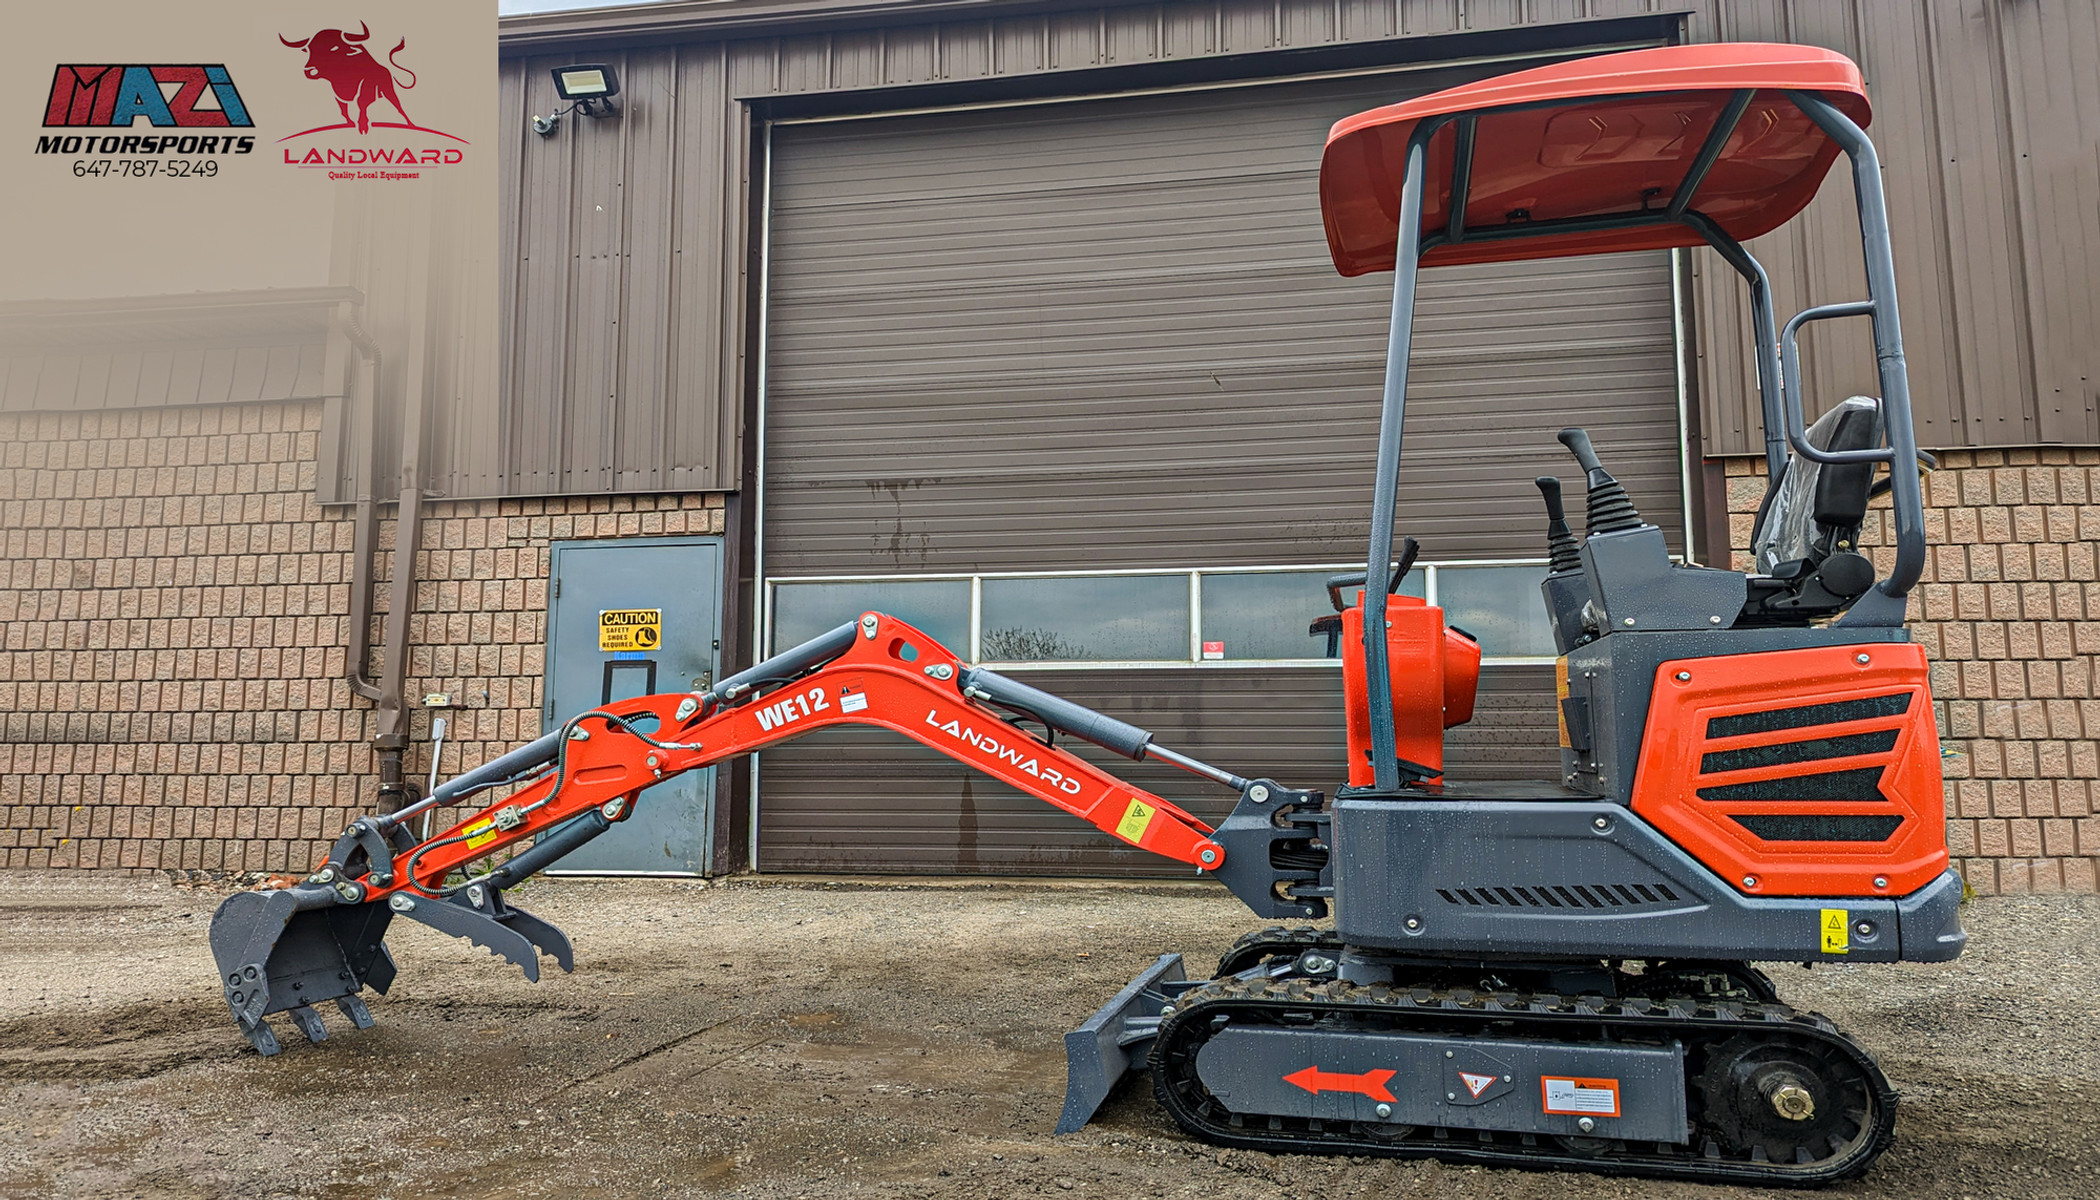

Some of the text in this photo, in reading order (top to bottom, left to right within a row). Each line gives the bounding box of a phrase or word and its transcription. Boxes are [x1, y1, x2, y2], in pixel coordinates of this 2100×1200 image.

[604, 612, 656, 624] CAUTION
[755, 687, 830, 732] WE12
[925, 709, 1082, 795] LANDWARD
